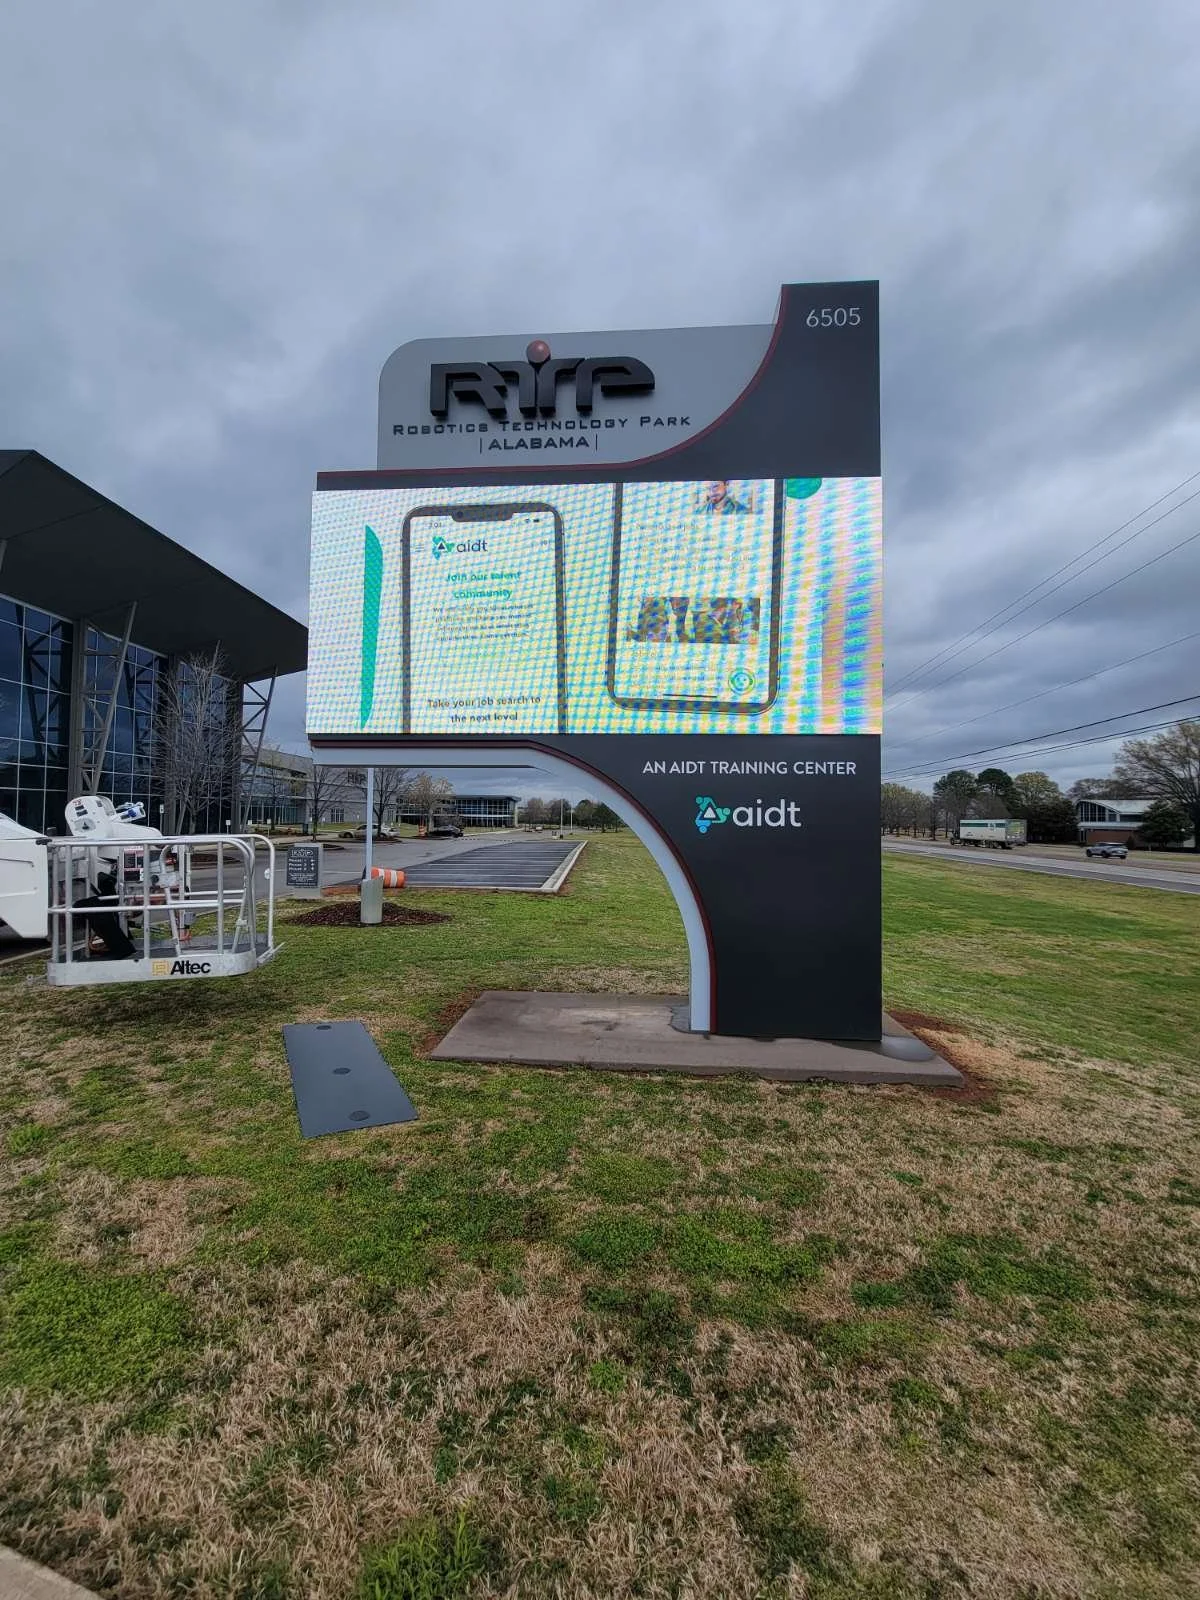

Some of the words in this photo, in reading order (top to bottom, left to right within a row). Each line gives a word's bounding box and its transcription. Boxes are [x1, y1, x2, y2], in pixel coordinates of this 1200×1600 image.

[805, 306, 862, 328] 6505
[393, 422, 489, 435] ROBOTICS
[500, 418, 629, 432] TECHNOLOGY
[639, 415, 692, 427] PARK
[488, 436, 590, 450] ALABAMA
[456, 539, 488, 553] aidt
[453, 588, 512, 600] community
[428, 699, 450, 709] Take
[452, 699, 475, 709] your
[478, 697, 494, 709] job
[496, 695, 529, 705] search
[530, 695, 541, 705] to
[451, 713, 467, 724] the
[469, 712, 491, 723] next
[493, 711, 518, 722] level
[642, 760, 666, 775] AN
[668, 760, 706, 775] AIDT
[710, 761, 788, 775] TRAINING
[793, 761, 857, 775] CENTER
[732, 798, 802, 828] aidt
[171, 960, 211, 975] Altec
